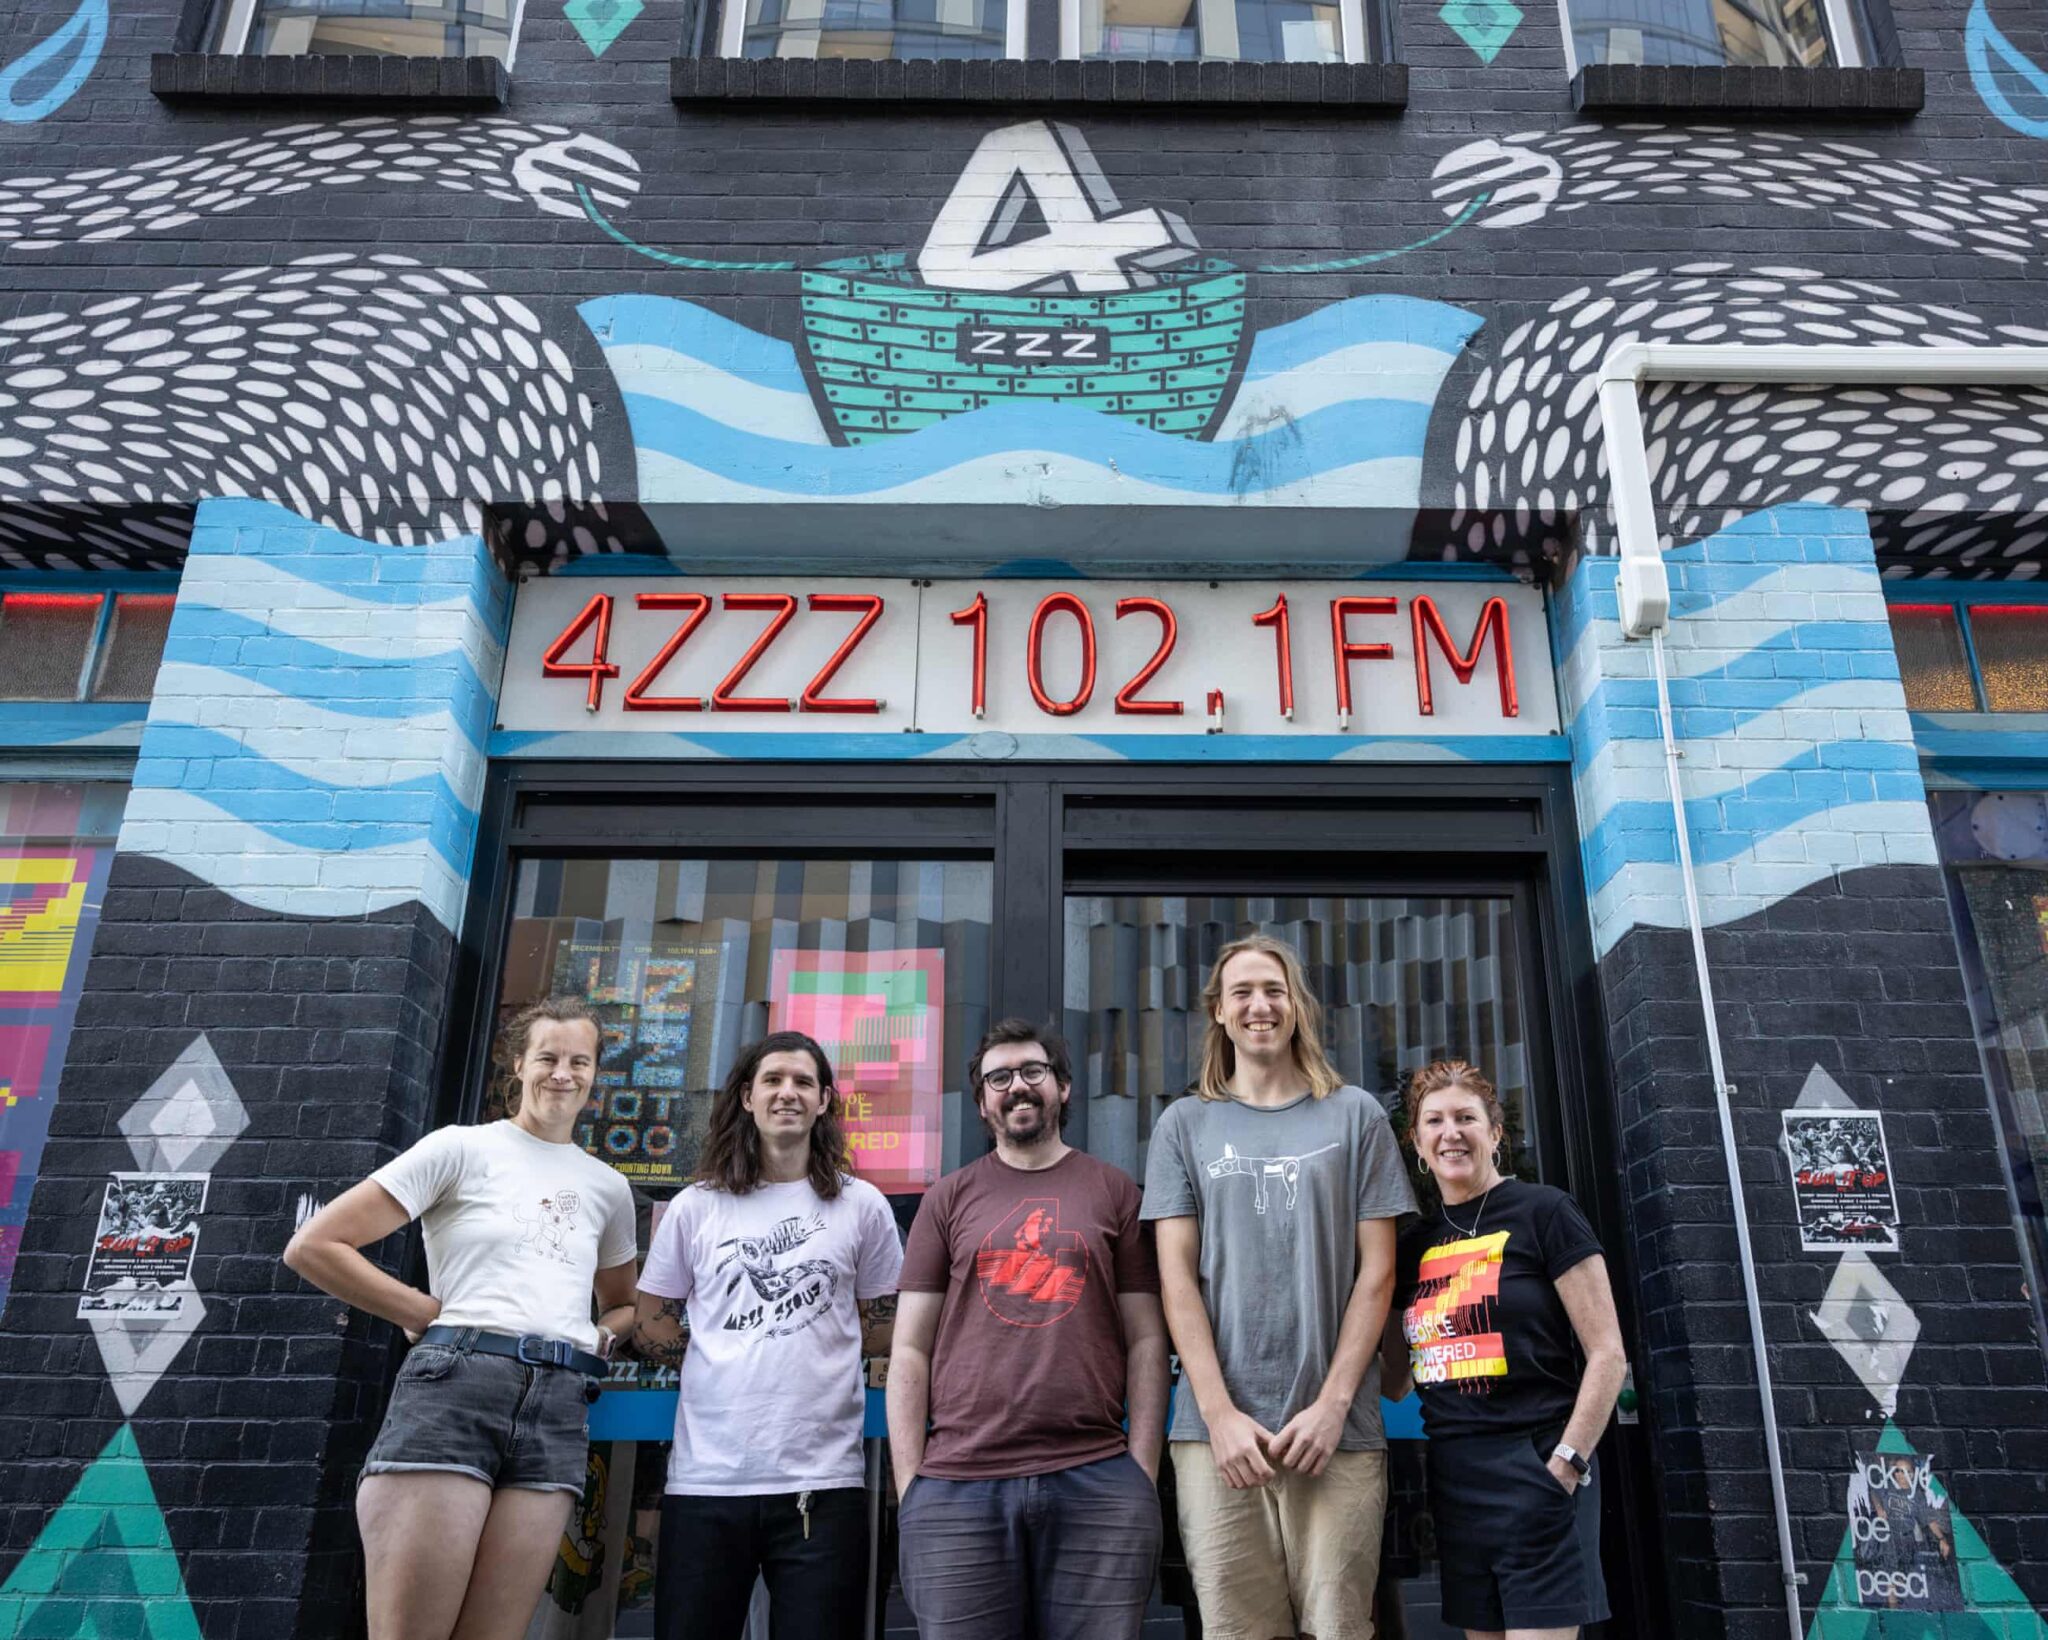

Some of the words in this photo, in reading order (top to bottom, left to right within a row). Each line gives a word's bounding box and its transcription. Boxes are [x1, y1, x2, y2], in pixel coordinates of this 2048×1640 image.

[917, 119, 1200, 293] 4
[970, 330, 1098, 359] ZZZ
[542, 592, 888, 714] 4ZZZ
[950, 590, 1519, 732] 102.1FM
[650, 1163, 672, 1175] DOWN
[1797, 1171, 1836, 1187] RUN
[98, 1235, 138, 1252] RUN
[723, 1305, 764, 1330] MESS
[1855, 1564, 1929, 1604] pesci
